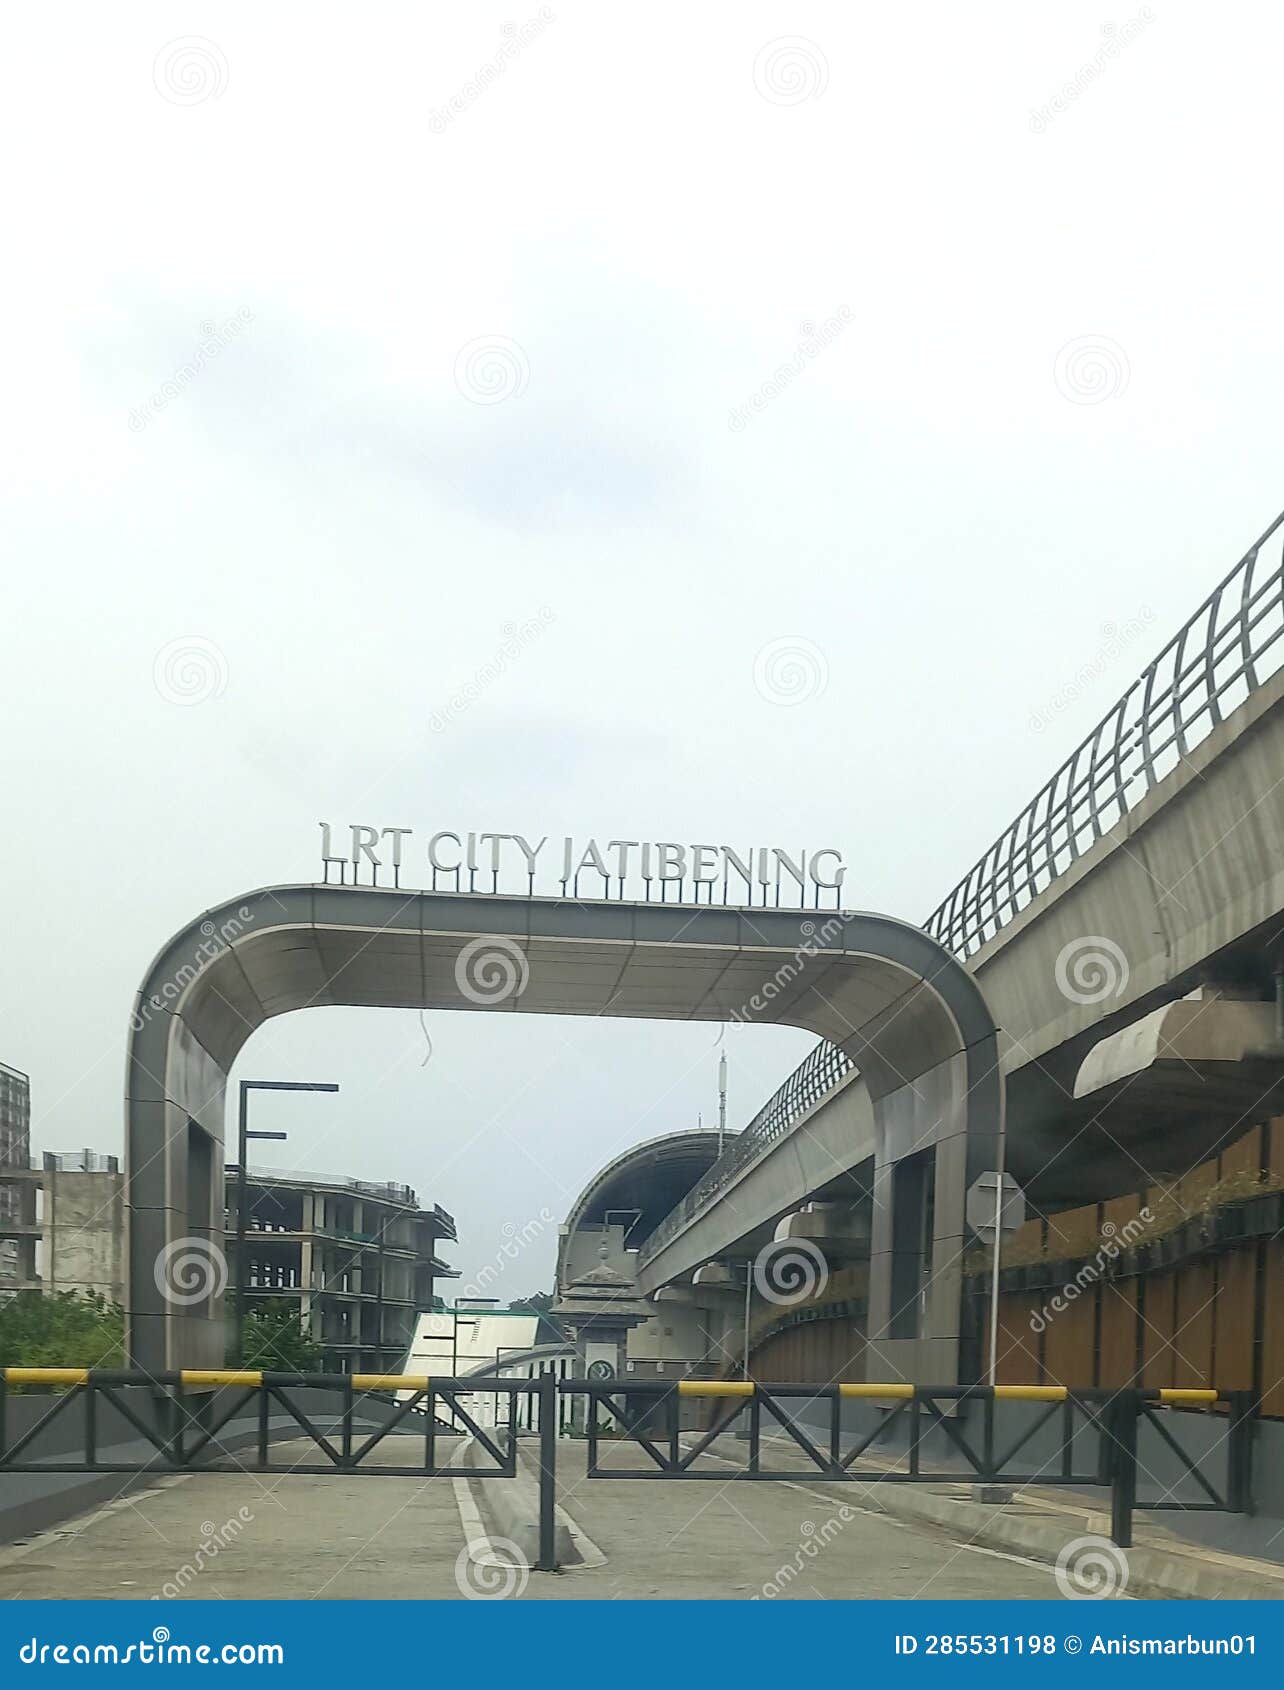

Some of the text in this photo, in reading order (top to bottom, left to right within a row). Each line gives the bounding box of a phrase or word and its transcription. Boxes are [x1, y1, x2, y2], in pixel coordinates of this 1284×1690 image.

[319, 821, 847, 889] LRT CITY JATIBENING
